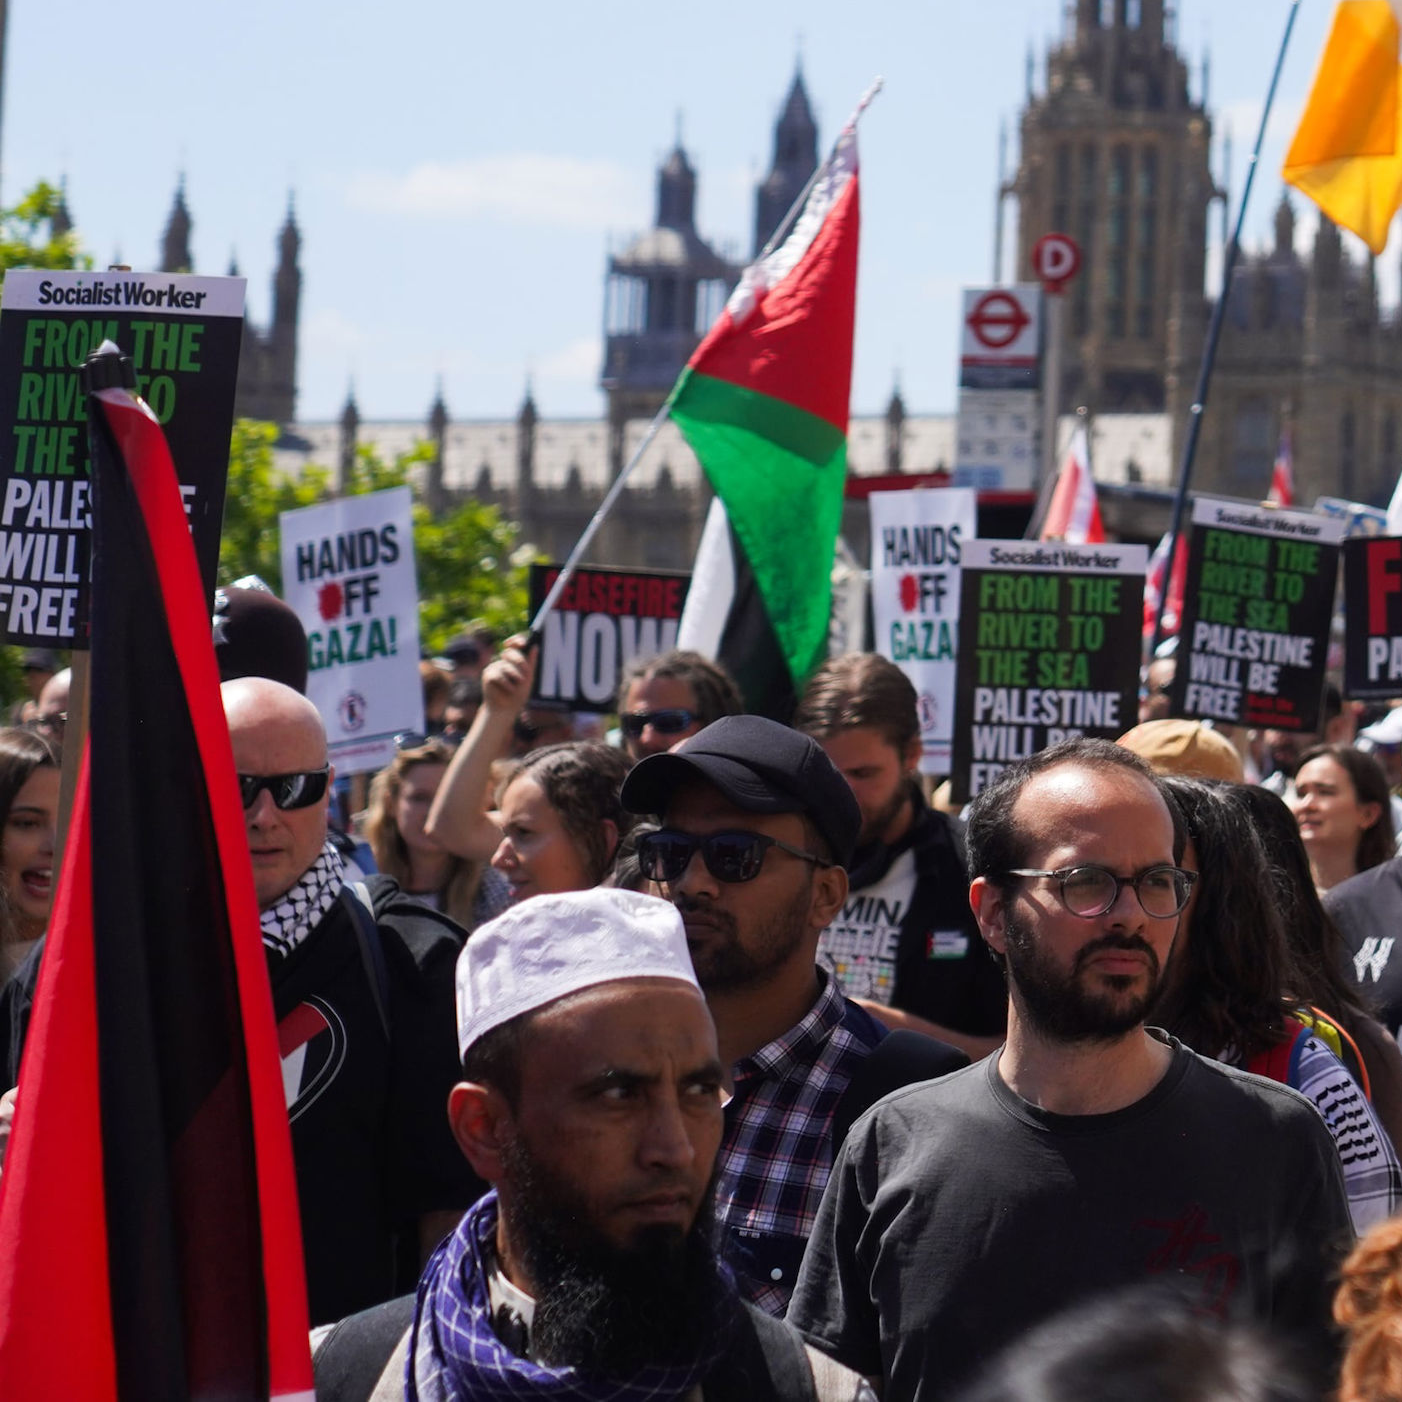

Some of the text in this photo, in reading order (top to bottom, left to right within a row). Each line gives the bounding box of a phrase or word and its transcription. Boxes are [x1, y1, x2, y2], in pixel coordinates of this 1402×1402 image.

[1043, 240, 1075, 275] D
[131, 320, 205, 373] THE
[17, 371, 89, 422] RIVE
[13, 426, 78, 475] THE
[0, 530, 80, 584] WILL
[295, 523, 399, 582] HANDS
[882, 524, 961, 567] HANDS
[1204, 529, 1321, 575] FROM THE
[979, 573, 1122, 615] FROM THE
[1202, 560, 1305, 603] RIVER TO
[976, 612, 1104, 652] RIVER TO
[1198, 591, 1290, 633] THE SEA
[307, 614, 398, 673] GAZA!
[540, 609, 678, 705] NOW
[1193, 621, 1316, 668] PALESTINE
[976, 650, 1090, 689] THE SEA
[1188, 653, 1280, 696] WILL BE
[972, 686, 1123, 729] PALESTINE
[1184, 682, 1242, 721] FREE
[970, 724, 1035, 763] WILL
